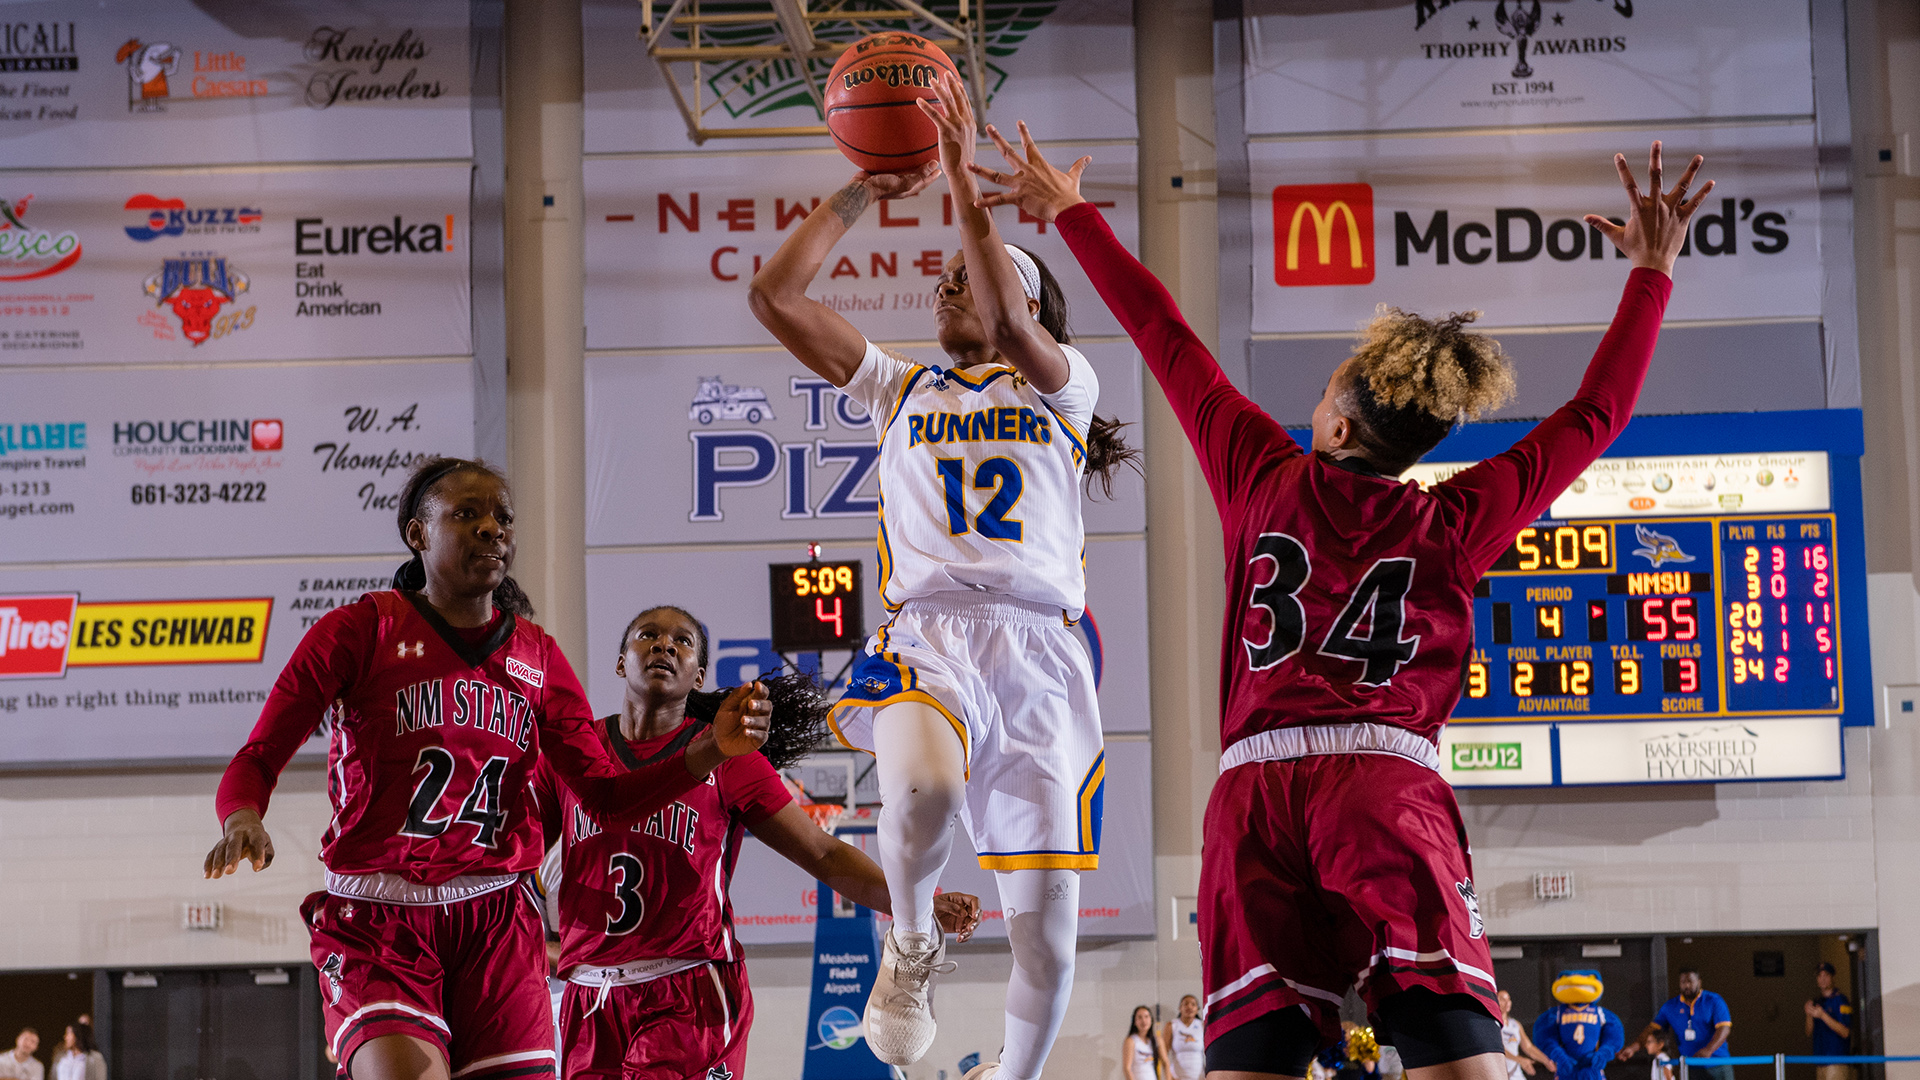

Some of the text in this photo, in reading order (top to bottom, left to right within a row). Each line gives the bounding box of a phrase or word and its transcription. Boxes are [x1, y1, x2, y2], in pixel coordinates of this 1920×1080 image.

[0, 22, 75, 54] ICALI
[1421, 36, 1627, 59] TROPHY AWARDS
[194, 51, 246, 72] Little
[304, 26, 428, 74] Knights
[191, 75, 268, 97] Caesars
[843, 63, 938, 90] Wilson
[1492, 81, 1554, 95] EST. 1994
[304, 67, 448, 110] Jewelers
[169, 208, 238, 225] KUZZ
[295, 214, 454, 255] Eureka!
[1394, 198, 1789, 267] McDond's
[297, 262, 324, 279] Eat
[297, 281, 343, 297] Drink
[0, 305, 70, 316] 99-5512
[297, 300, 381, 317] American
[822, 293, 935, 312] blished 1910
[344, 403, 421, 432] W.A.
[908, 406, 1053, 449] RUNNERS
[113, 419, 250, 444] HOUCHIN
[45, 456, 86, 469] Travel
[1715, 457, 1752, 469] AUTO
[1758, 456, 1805, 468] GROUP
[131, 482, 267, 504] 661-323-4222
[936, 456, 1024, 543] 12
[1729, 524, 1820, 540] PLYR FLS PTS
[1516, 526, 1607, 570] 5:09
[1744, 544, 1829, 573] 2 3 16
[313, 577, 393, 591] BAKERSFI
[793, 566, 853, 596] 5:09
[1627, 571, 1691, 595] NMSU
[1747, 572, 1829, 600] 3 0 2
[290, 598, 335, 610] AREA
[1526, 587, 1573, 601] PERIOD
[815, 597, 843, 638] 4
[1242, 532, 1421, 687] 34
[1642, 597, 1696, 641] 55
[1729, 602, 1831, 628] 20 1 11
[76, 619, 121, 648] LES
[130, 616, 255, 647] SCHWAB
[1540, 606, 1560, 637] 4
[1730, 625, 1832, 655] 24 1 5
[1508, 647, 1540, 661] FOUL
[1545, 645, 1592, 660] PLAYER
[1610, 645, 1644, 659] T.O.L.
[1660, 643, 1701, 658] FOULS
[508, 661, 541, 684] WAC
[1469, 658, 1697, 699] 3 2 12 3 3
[1733, 655, 1833, 684] 34 2 1
[26, 692, 57, 708] the
[66, 691, 117, 710] right
[126, 689, 179, 707] thing
[1518, 697, 1704, 712] ADVANTAGE SCORE
[395, 679, 444, 736] NM
[453, 679, 535, 752] STATE
[1645, 739, 1757, 758] BAKERSFIELD
[1647, 758, 1755, 778] HYUNDAI
[400, 746, 509, 850] 24
[606, 852, 645, 936] 3
[1542, 876, 1568, 894] EXIT
[819, 953, 869, 965] Meadows
[830, 967, 857, 980] Field
[823, 983, 861, 996] Airport
[1573, 1024, 1585, 1045] 4
